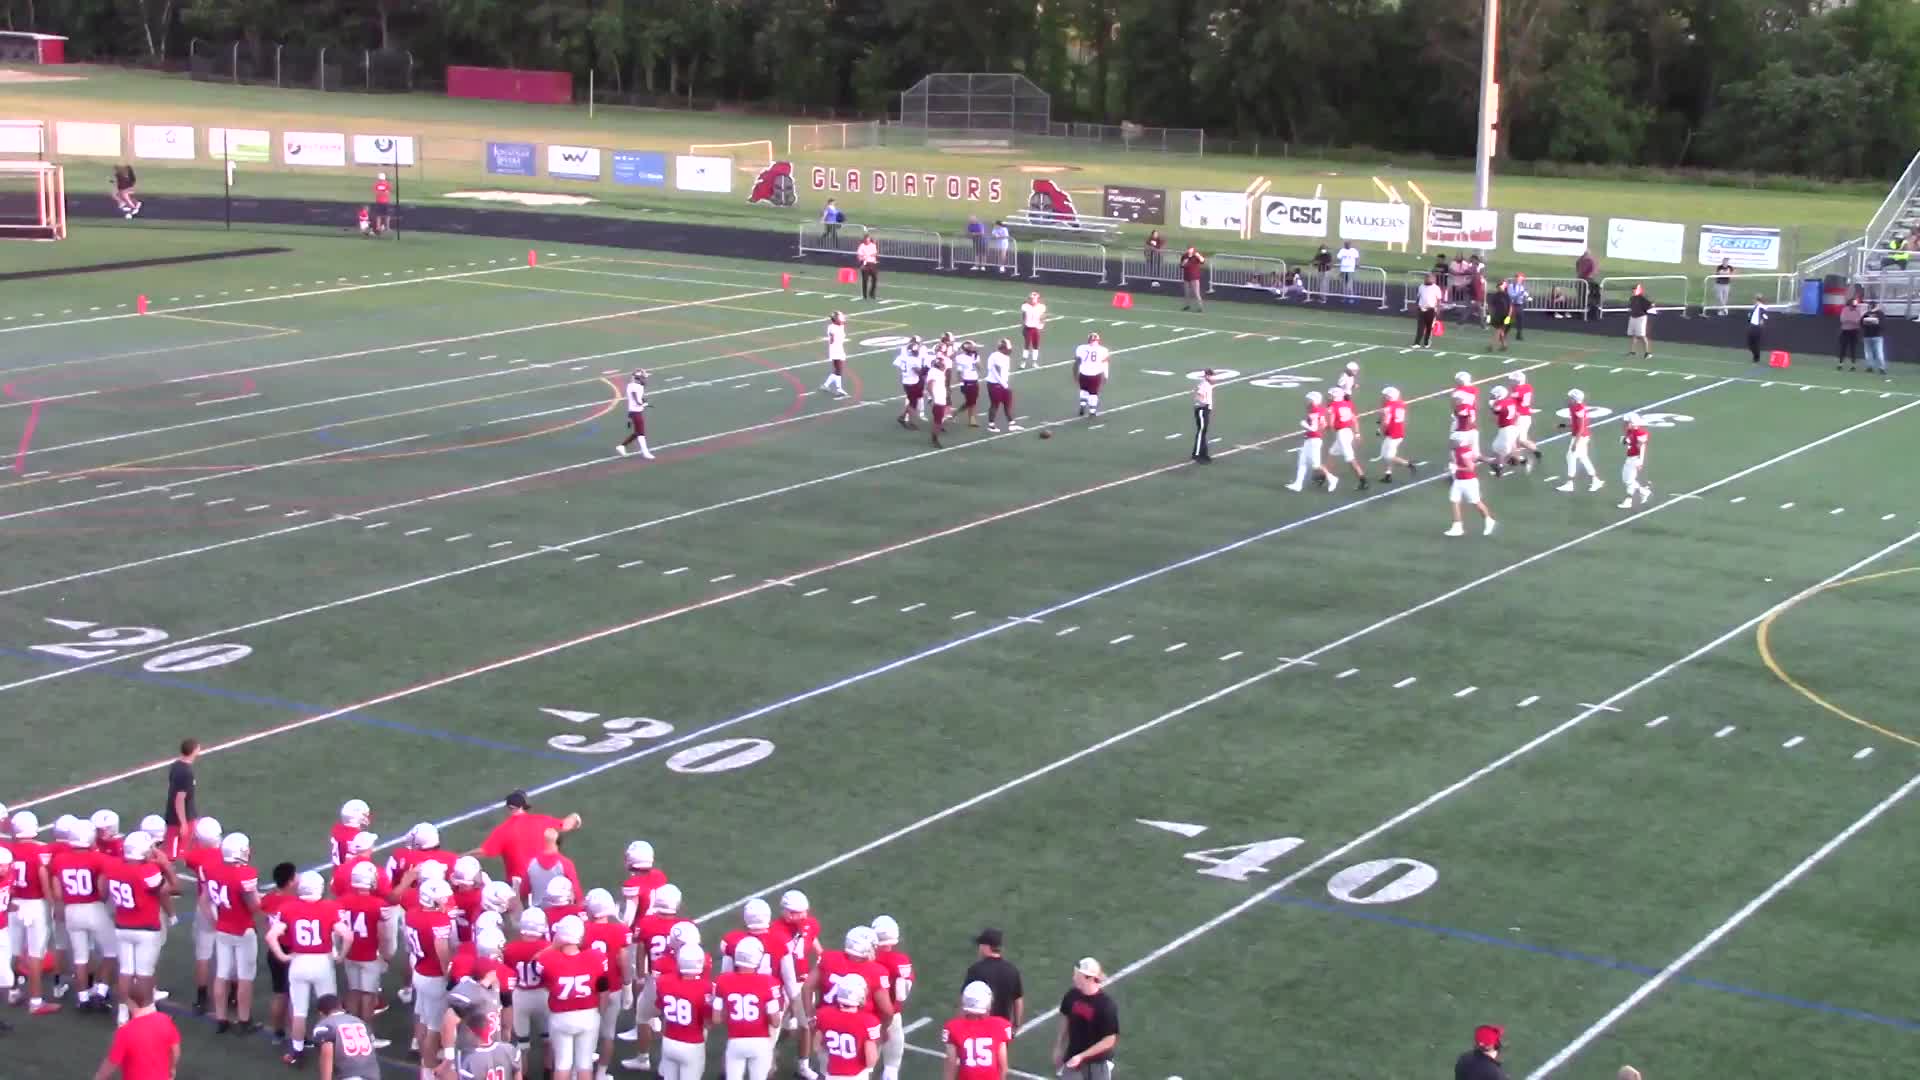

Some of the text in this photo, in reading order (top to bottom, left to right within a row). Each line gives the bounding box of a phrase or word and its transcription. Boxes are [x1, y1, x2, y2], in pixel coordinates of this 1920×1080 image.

[811, 166, 1001, 202] GLADIATORS
[1289, 205, 1322, 224] CSC
[61, 868, 94, 897] 50
[109, 879, 137, 909] 59
[207, 879, 232, 910] 64
[294, 919, 323, 947] 61
[556, 974, 593, 1001] 75
[662, 994, 693, 1027] 28
[727, 993, 760, 1022] 36
[825, 1029, 858, 1060] 20
[963, 1036, 993, 1067] 15
